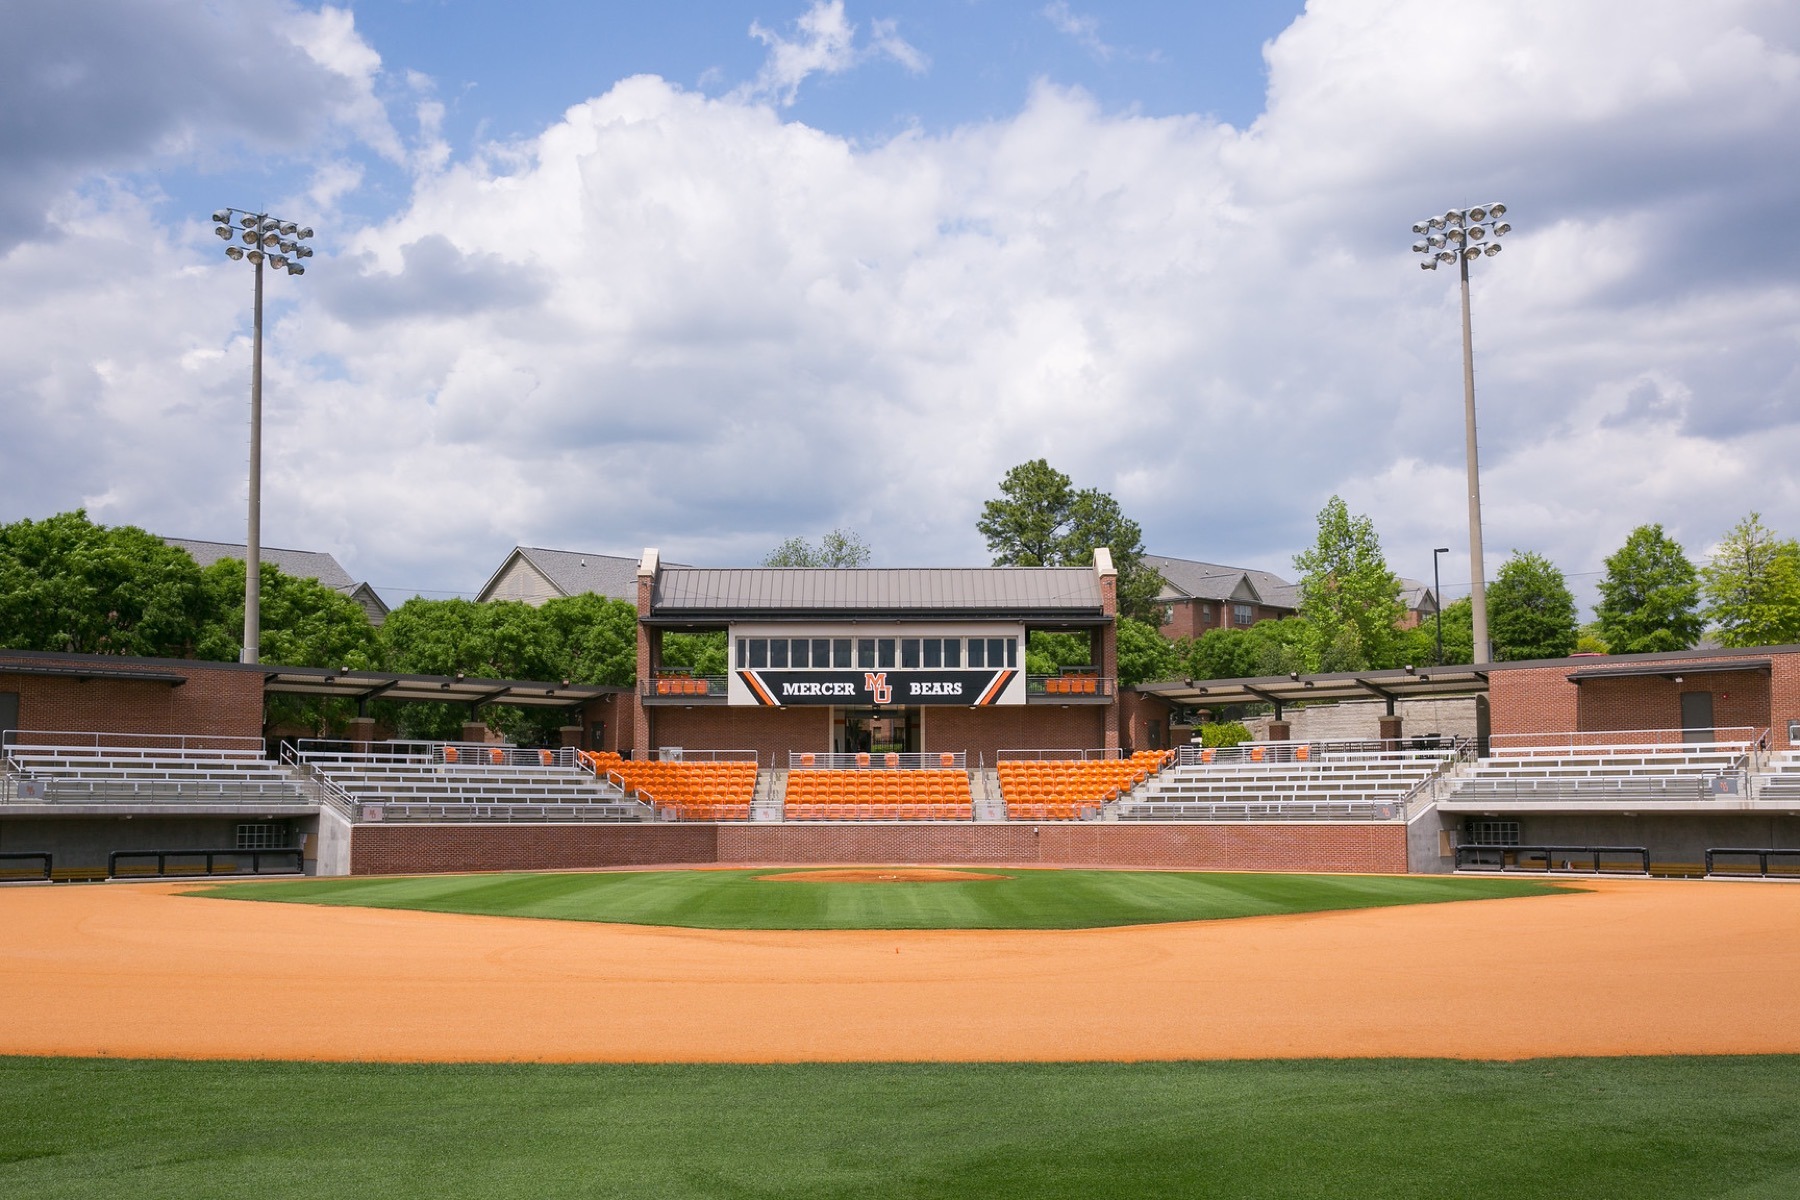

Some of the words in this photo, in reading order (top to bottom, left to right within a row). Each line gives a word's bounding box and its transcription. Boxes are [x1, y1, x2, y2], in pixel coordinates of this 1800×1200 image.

[782, 682, 856, 696] MERCER
[864, 672, 893, 704] MU
[909, 682, 963, 696] BEARS
